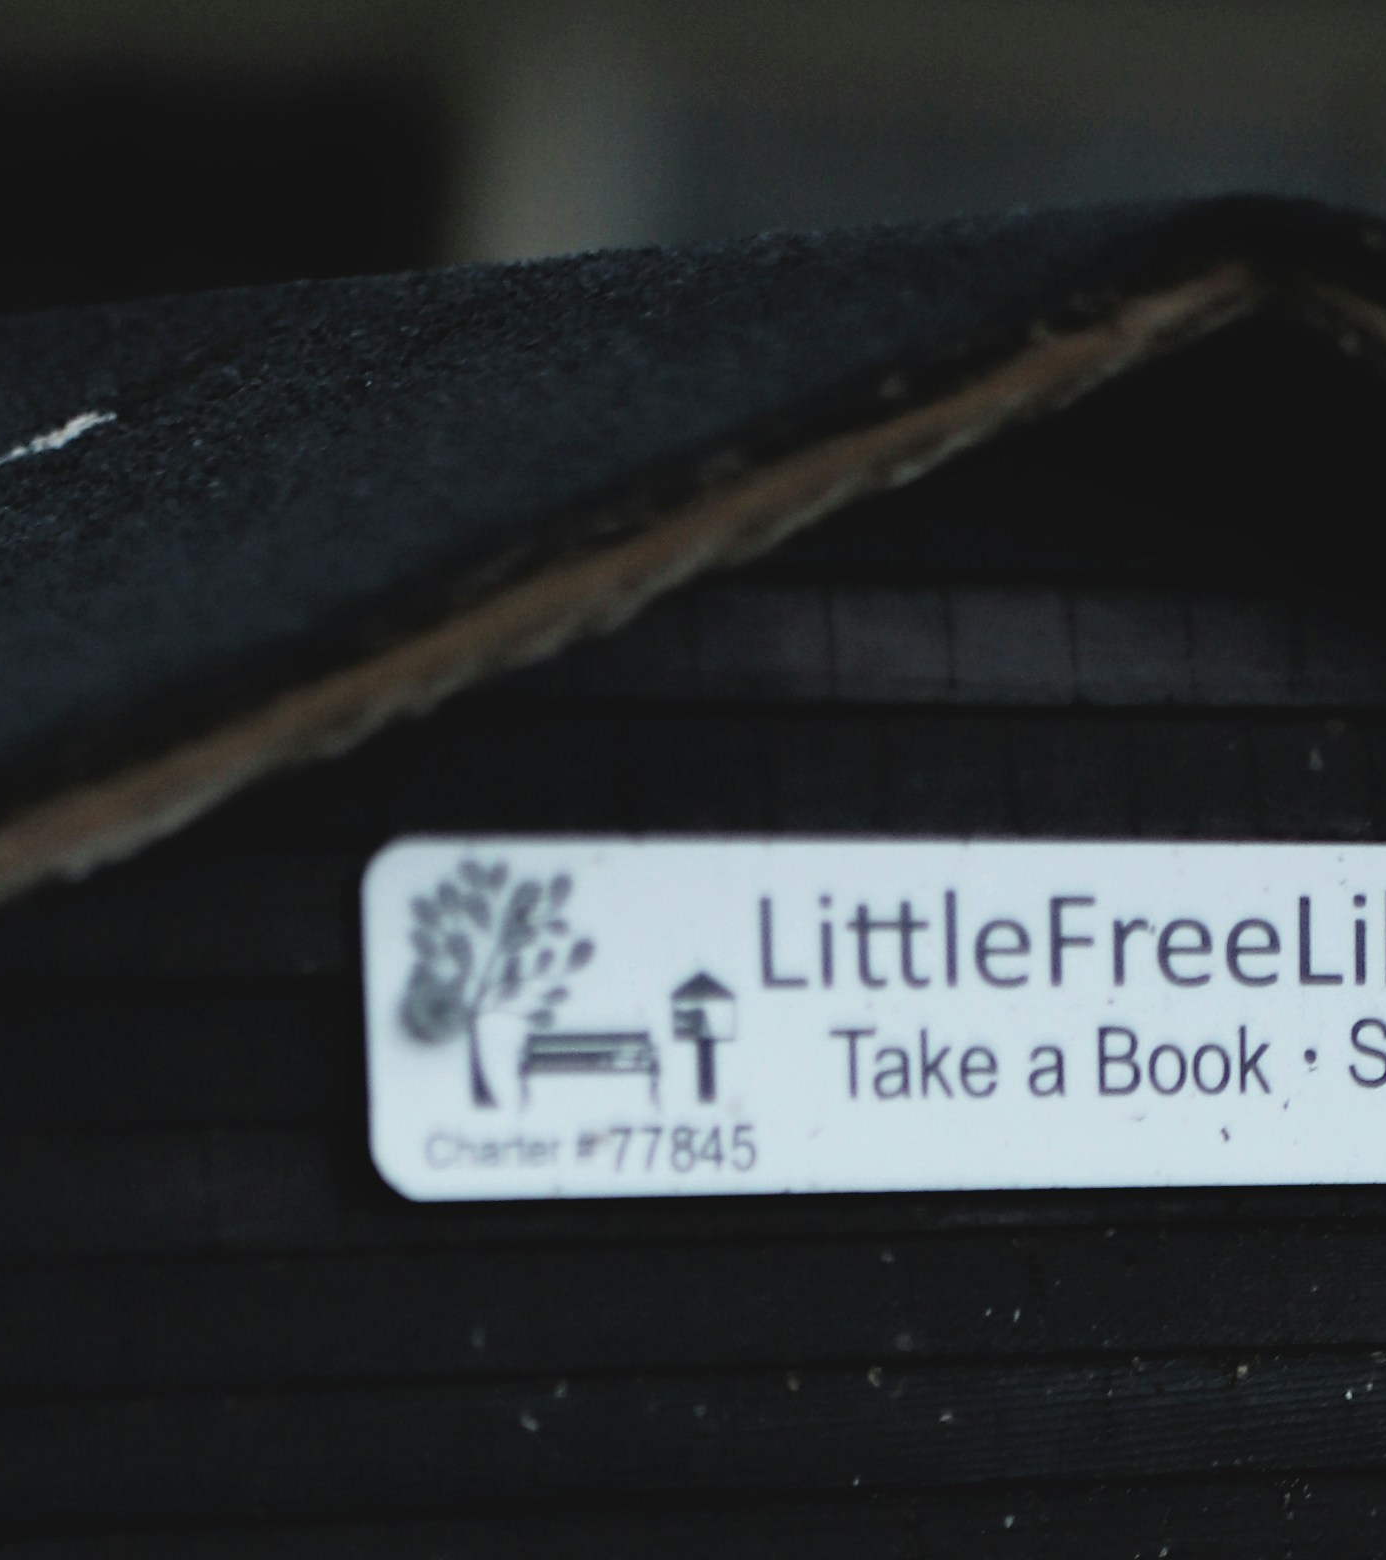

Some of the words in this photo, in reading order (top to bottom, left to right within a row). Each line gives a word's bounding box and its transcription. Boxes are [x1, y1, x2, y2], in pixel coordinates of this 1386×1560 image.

[829, 1026, 999, 1099] Take
[1027, 1044, 1067, 1098] a
[1098, 1025, 1271, 1097] Book
